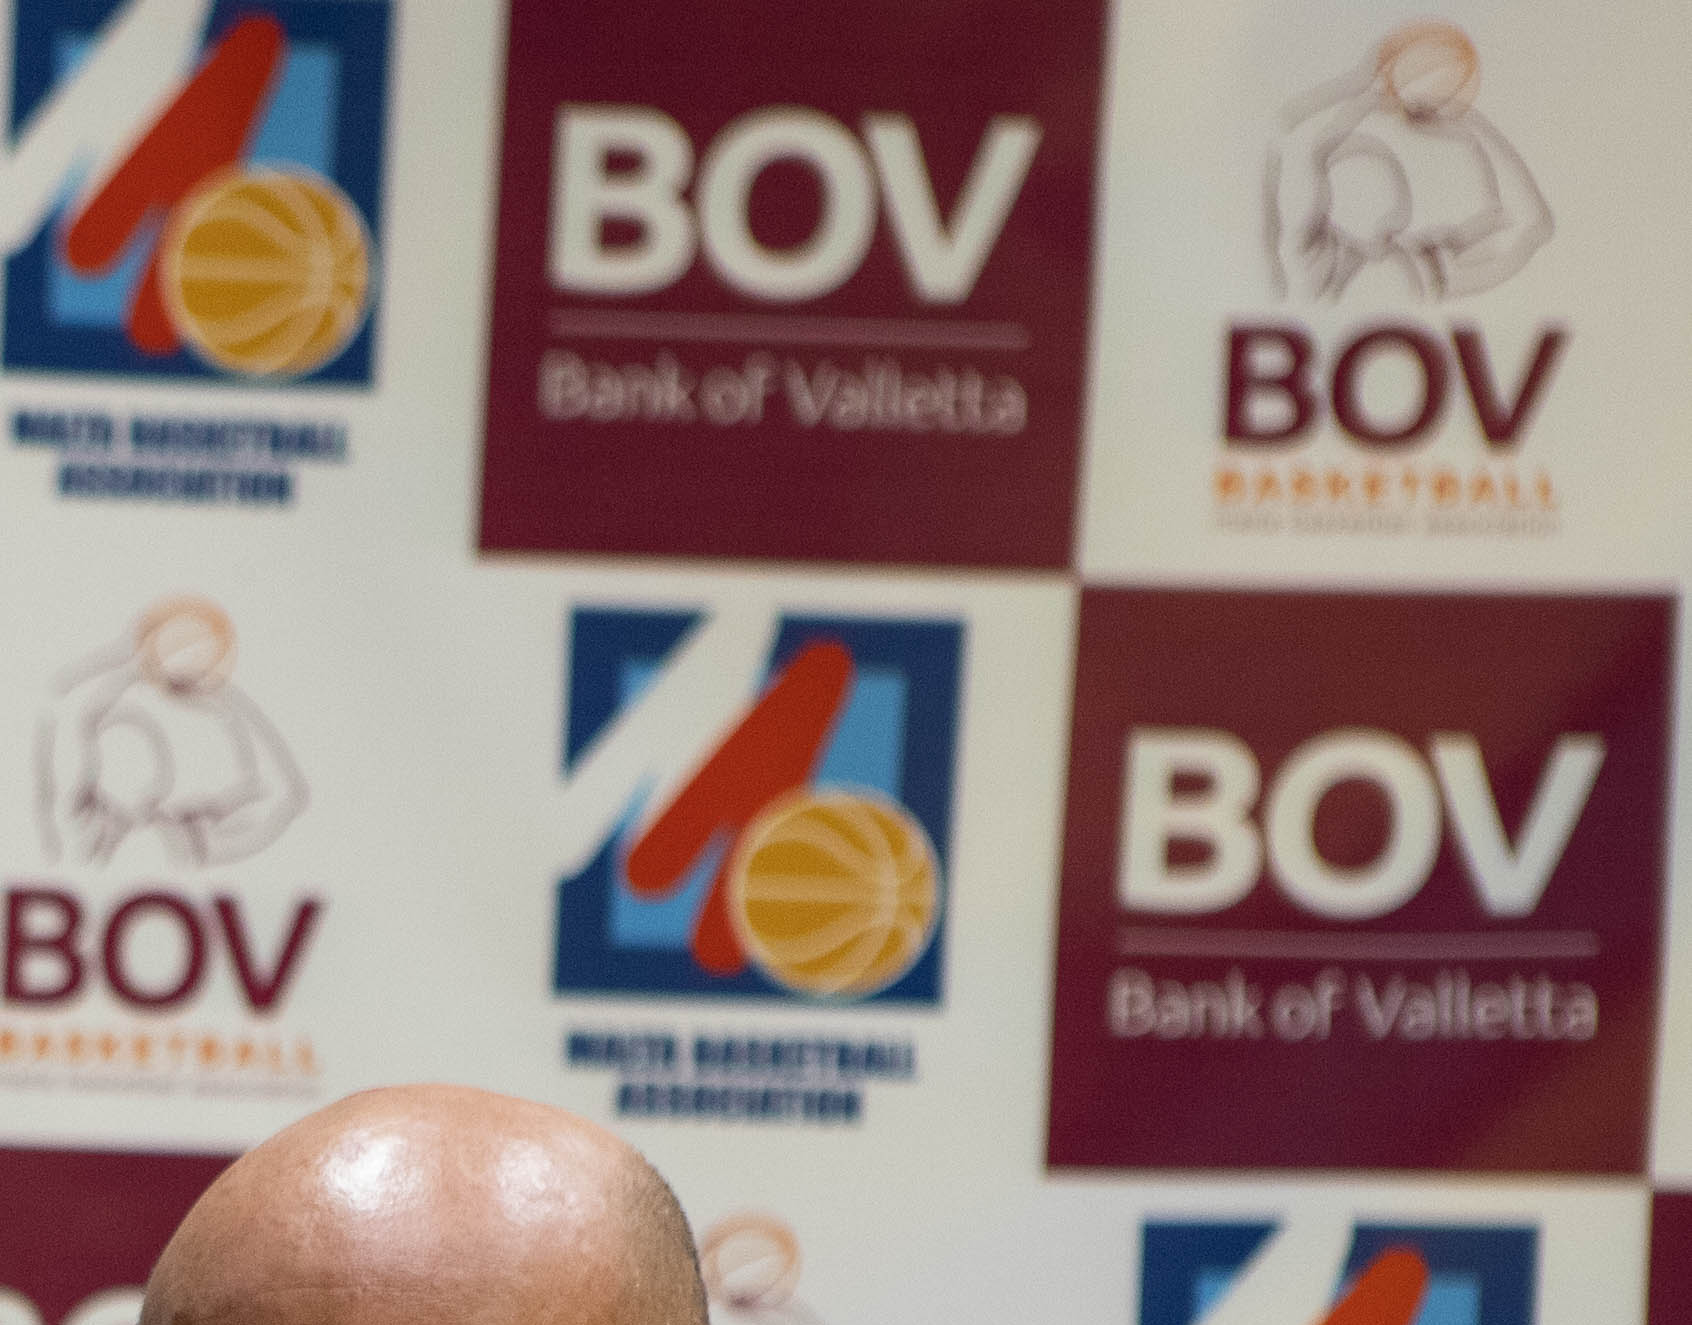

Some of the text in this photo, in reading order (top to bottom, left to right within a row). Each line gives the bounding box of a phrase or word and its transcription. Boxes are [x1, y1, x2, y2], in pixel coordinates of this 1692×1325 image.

[546, 102, 1043, 305] BOV
[538, 350, 1028, 436] Bank of Valletta
[1223, 319, 1571, 453] BOV
[1118, 727, 1606, 919] BOV
[1106, 965, 1600, 1041] Bank of Valletta
